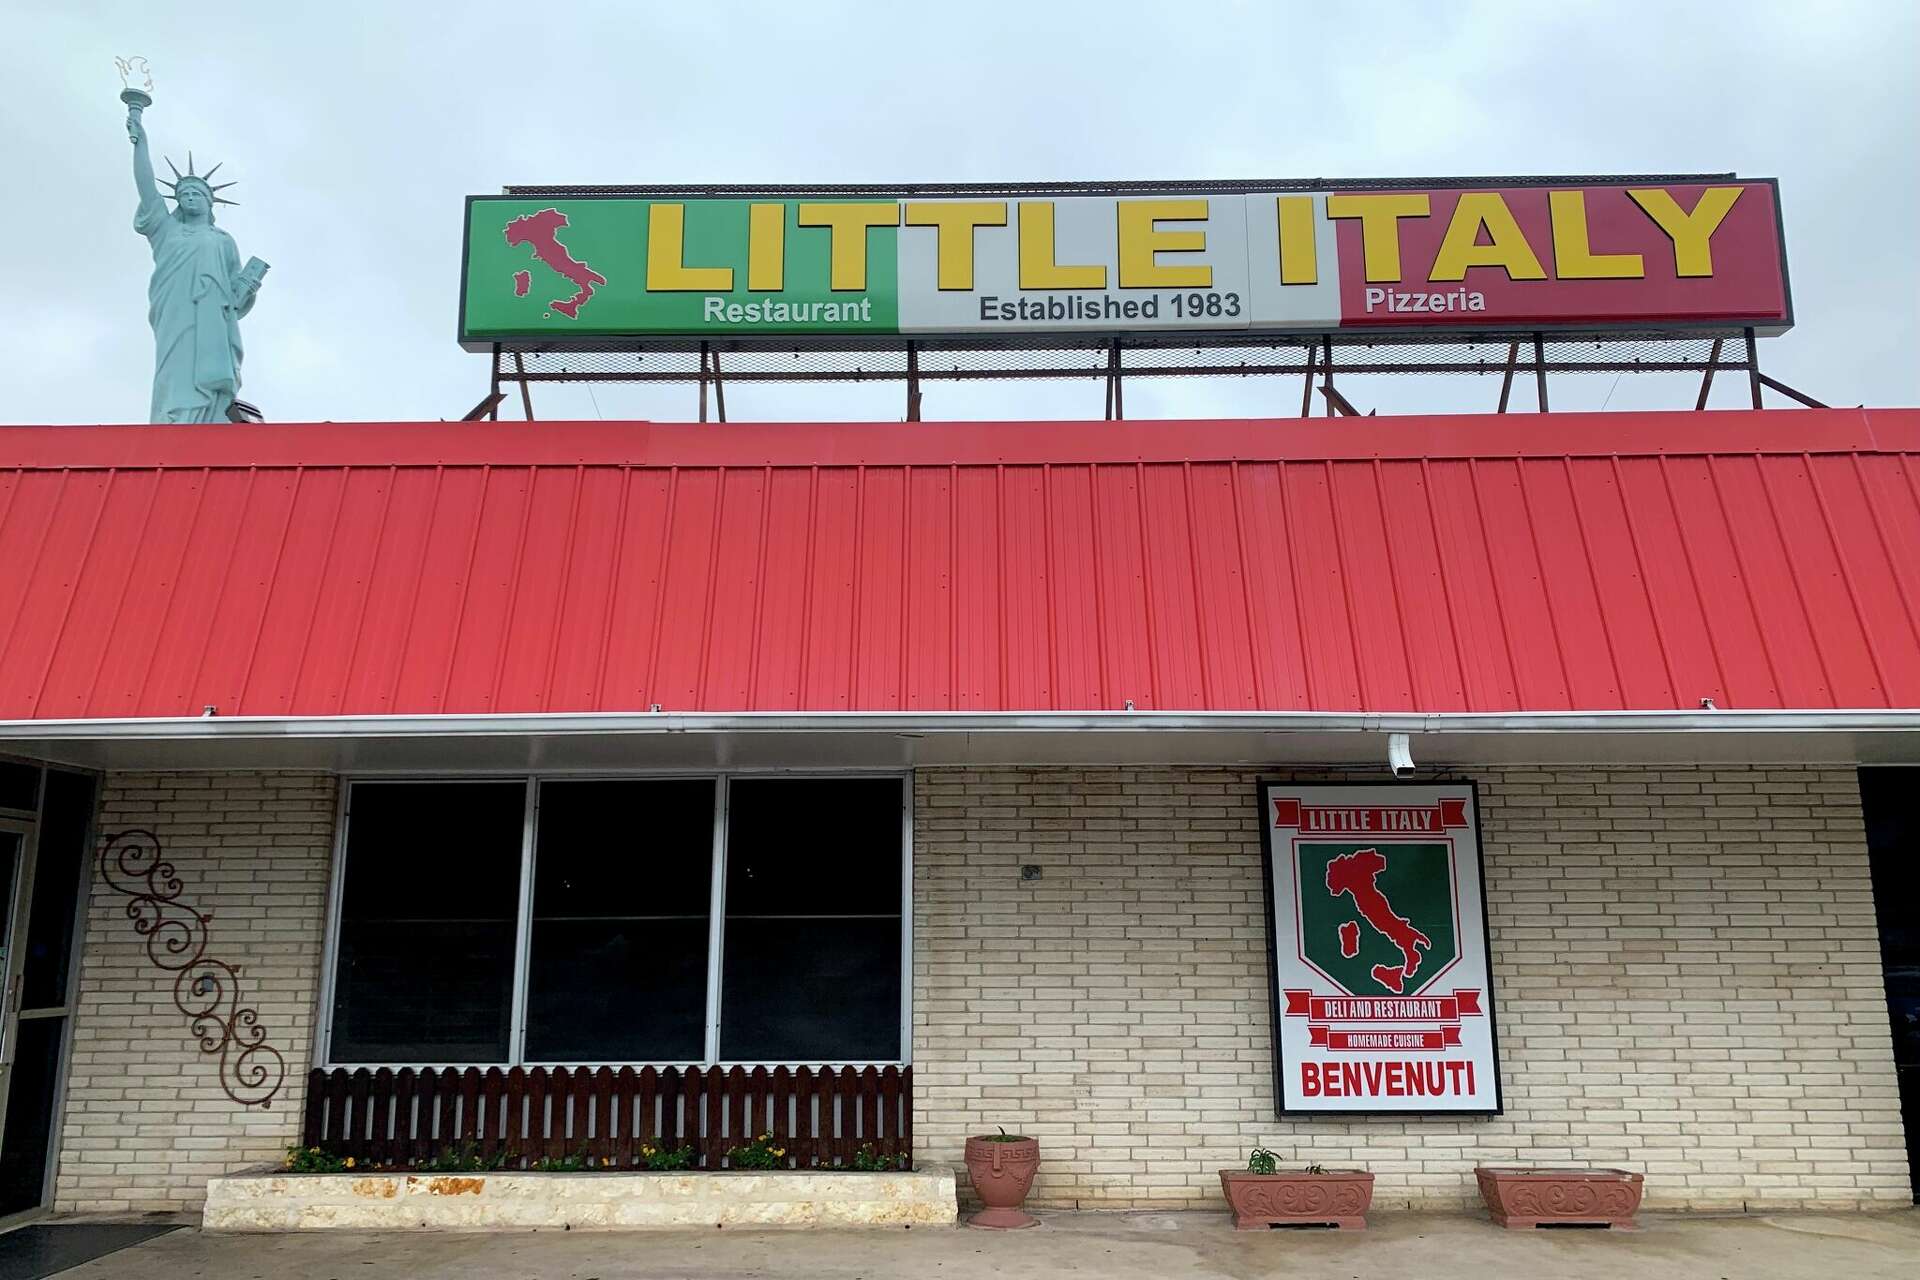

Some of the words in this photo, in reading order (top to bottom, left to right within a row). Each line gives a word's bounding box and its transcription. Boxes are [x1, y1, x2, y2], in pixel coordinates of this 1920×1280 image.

[645, 199, 1213, 292] LITTLE
[1276, 187, 1744, 285] ITALY
[703, 297, 872, 324] Restaurant
[980, 292, 1159, 322] Established
[1170, 291, 1241, 319] 1983
[1365, 289, 1486, 314] Pizzeria
[1309, 810, 1370, 831] LITTLE
[1381, 810, 1433, 830] ITALY
[1324, 1001, 1347, 1018] DELI
[1349, 1001, 1372, 1018] AND
[1374, 1000, 1443, 1018] RESTAURANT
[1347, 1033, 1393, 1048] HOMEMADE
[1393, 1033, 1425, 1047] CUISINE
[1301, 1060, 1476, 1097] BENVENUTI
